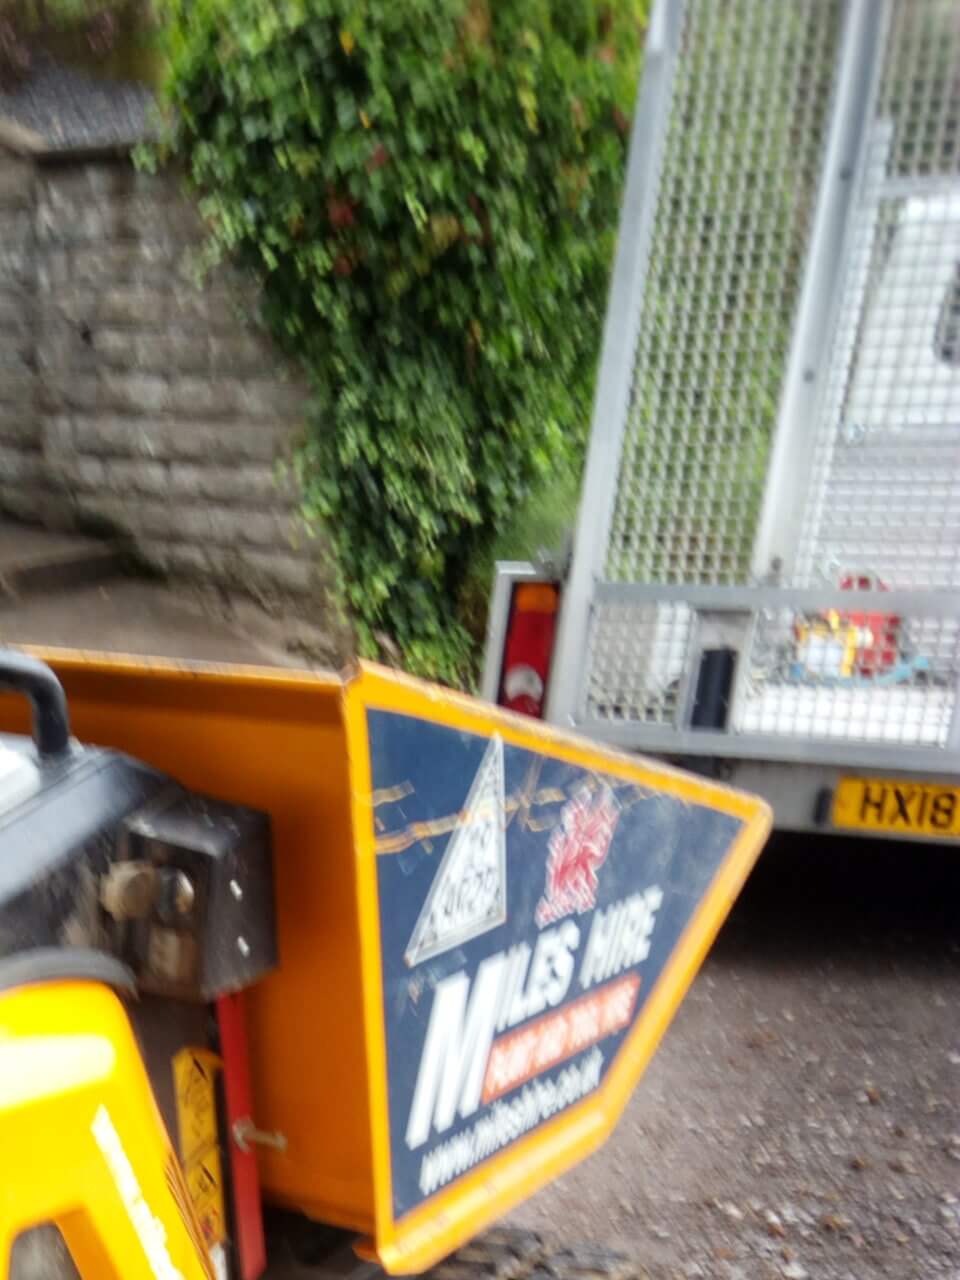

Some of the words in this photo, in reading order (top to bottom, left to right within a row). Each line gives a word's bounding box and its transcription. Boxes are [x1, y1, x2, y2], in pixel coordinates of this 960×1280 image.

[860, 784, 957, 829] HX18
[406, 921, 581, 1150] MILES
[579, 886, 664, 989] HIRE
